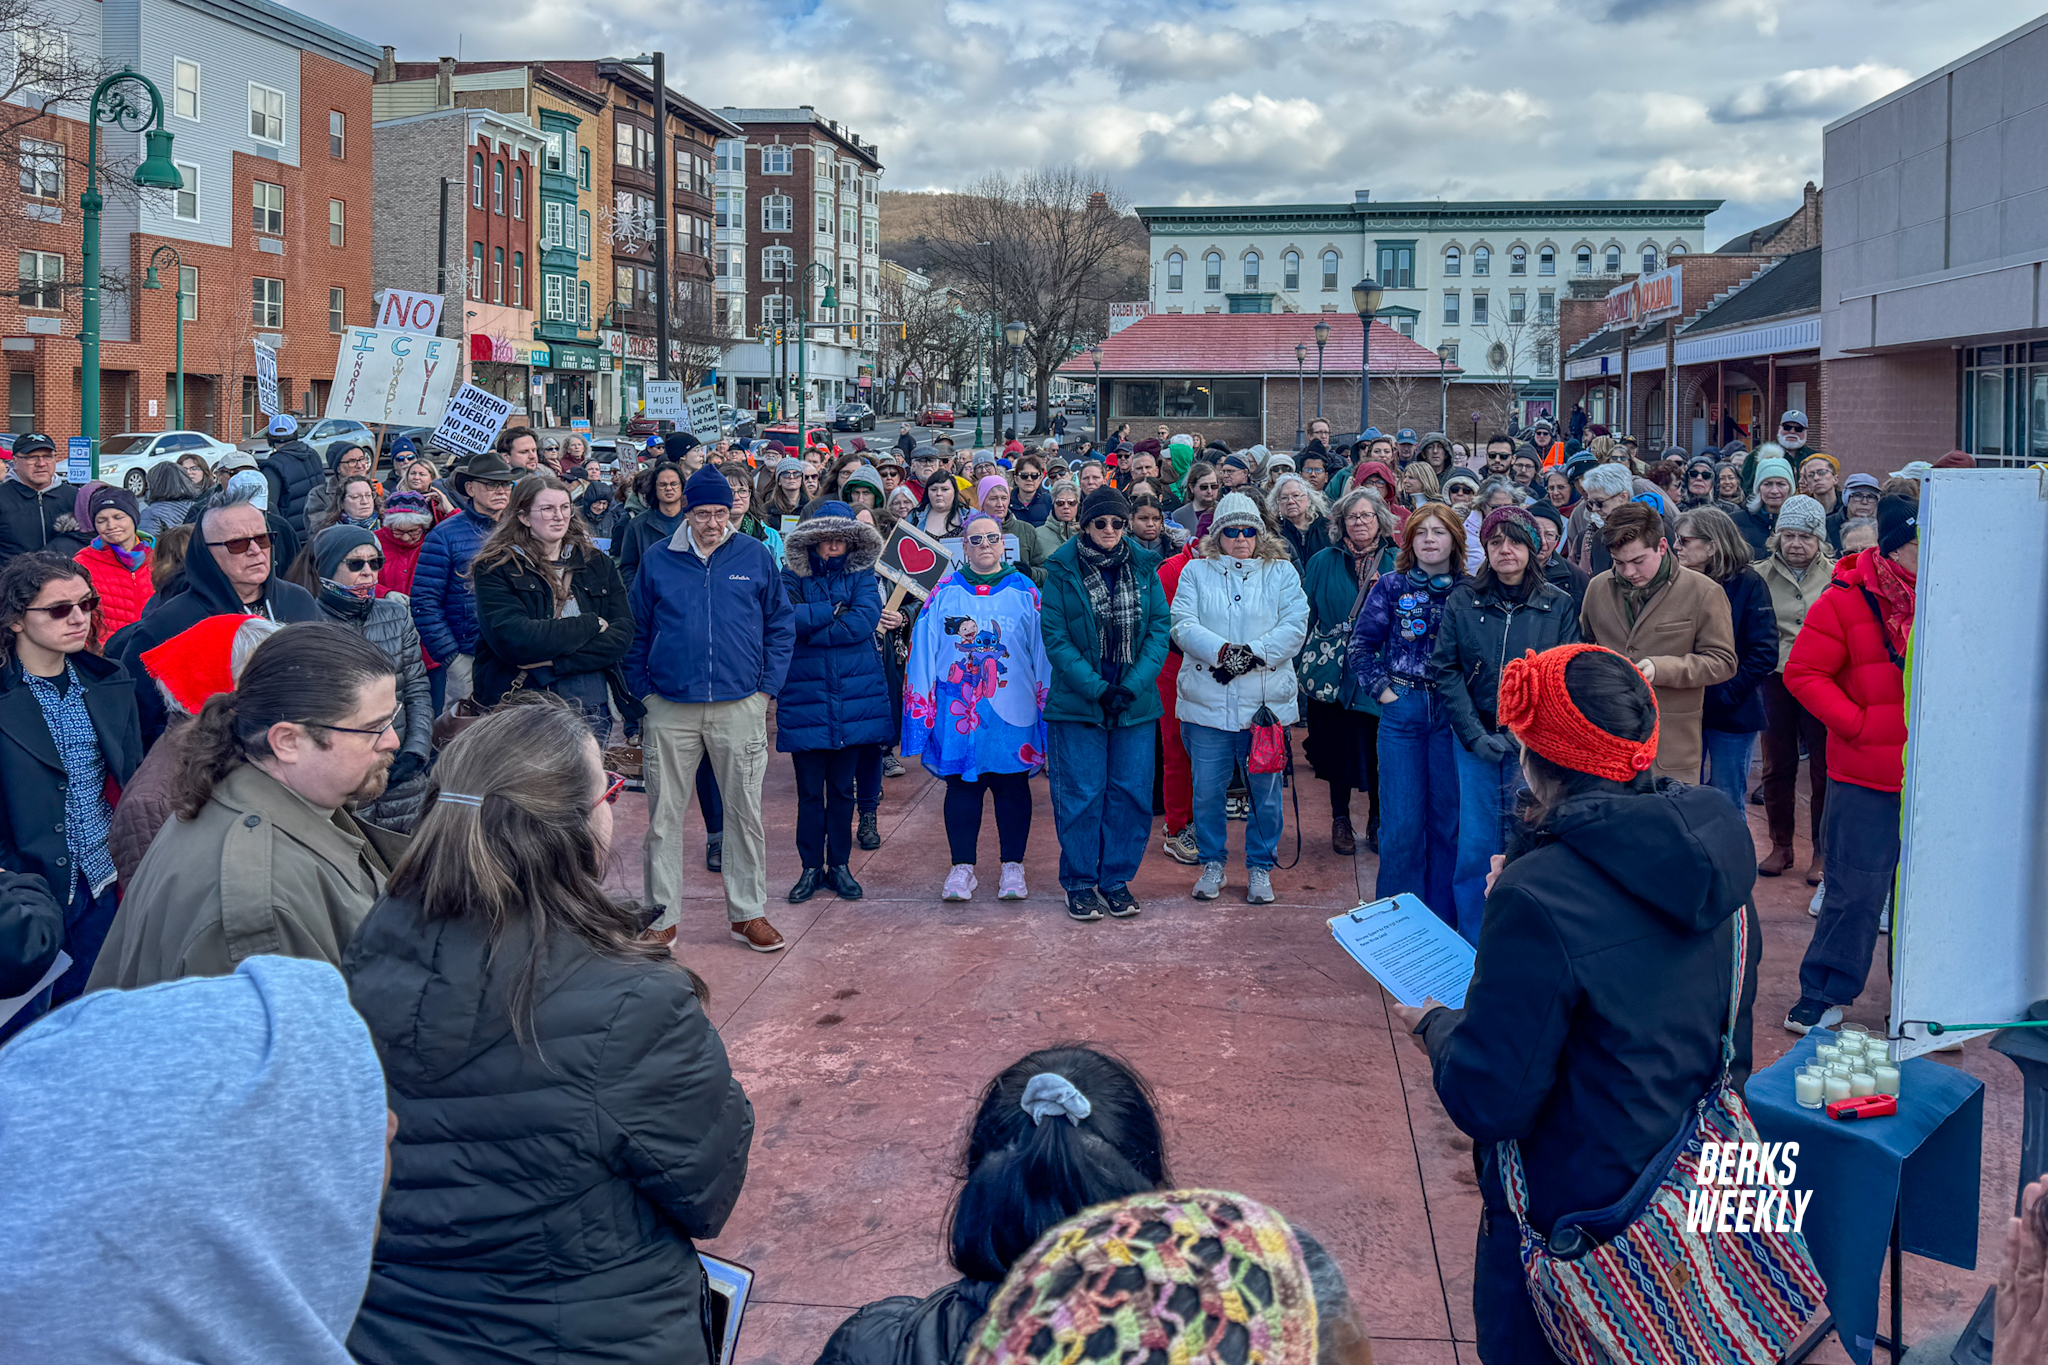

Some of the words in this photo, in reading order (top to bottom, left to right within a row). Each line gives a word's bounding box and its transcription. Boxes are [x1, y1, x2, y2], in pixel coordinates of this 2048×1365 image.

[1642, 274, 1672, 312] DOLLAR
[383, 293, 435, 330] NO
[1112, 304, 1133, 317] GOLDEN
[460, 388, 507, 416] ¡DINERO
[468, 402, 483, 413] PARA
[653, 396, 674, 405] MUST
[691, 393, 712, 405] Without
[692, 402, 715, 416] HOPE
[451, 401, 496, 434] PUEBLO,
[693, 418, 703, 426] we
[438, 425, 450, 437] LA
[450, 431, 486, 453] GUERRA!
[443, 415, 461, 430] NO
[461, 423, 490, 445] PARA
